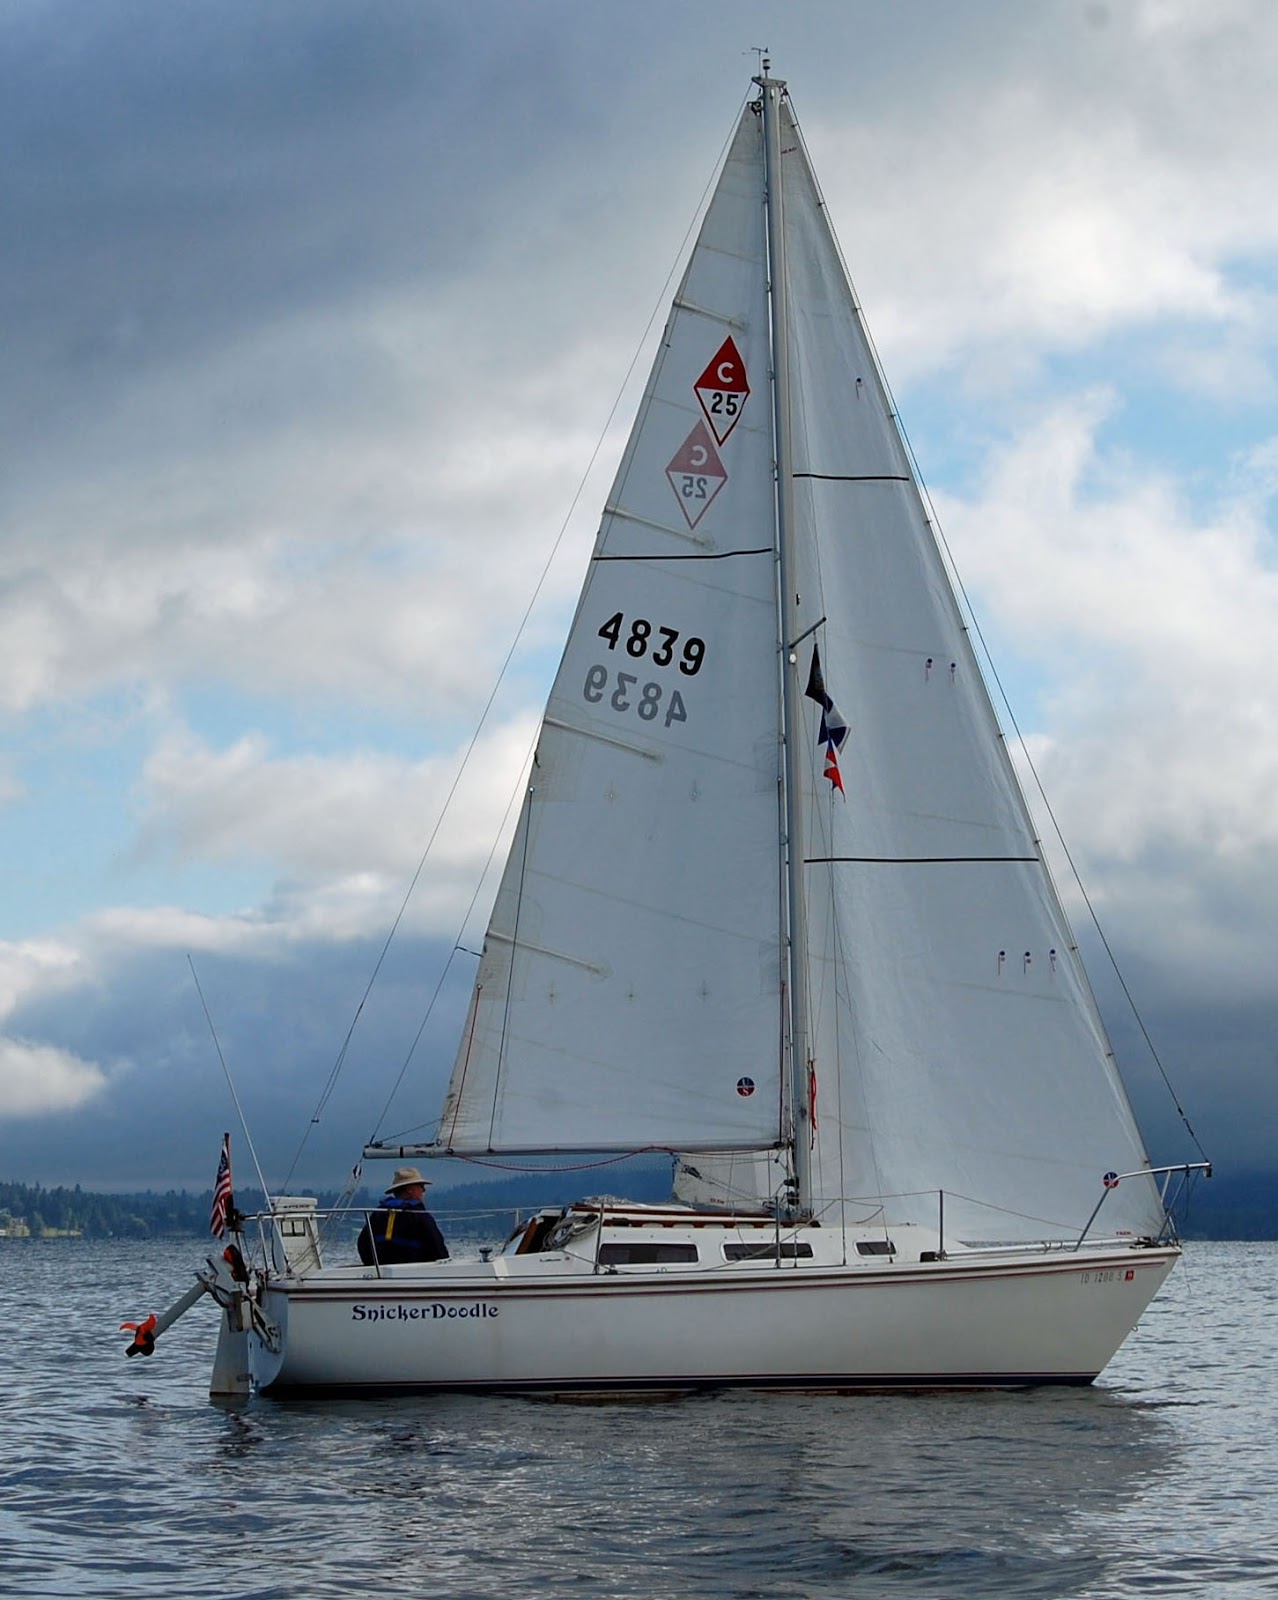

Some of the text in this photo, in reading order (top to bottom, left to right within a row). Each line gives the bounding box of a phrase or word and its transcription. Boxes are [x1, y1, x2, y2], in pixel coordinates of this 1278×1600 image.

[717, 362, 734, 383] C
[711, 392, 739, 416] 25
[598, 612, 706, 676] 4839
[352, 1303, 499, 1322] SnickerDoodle
